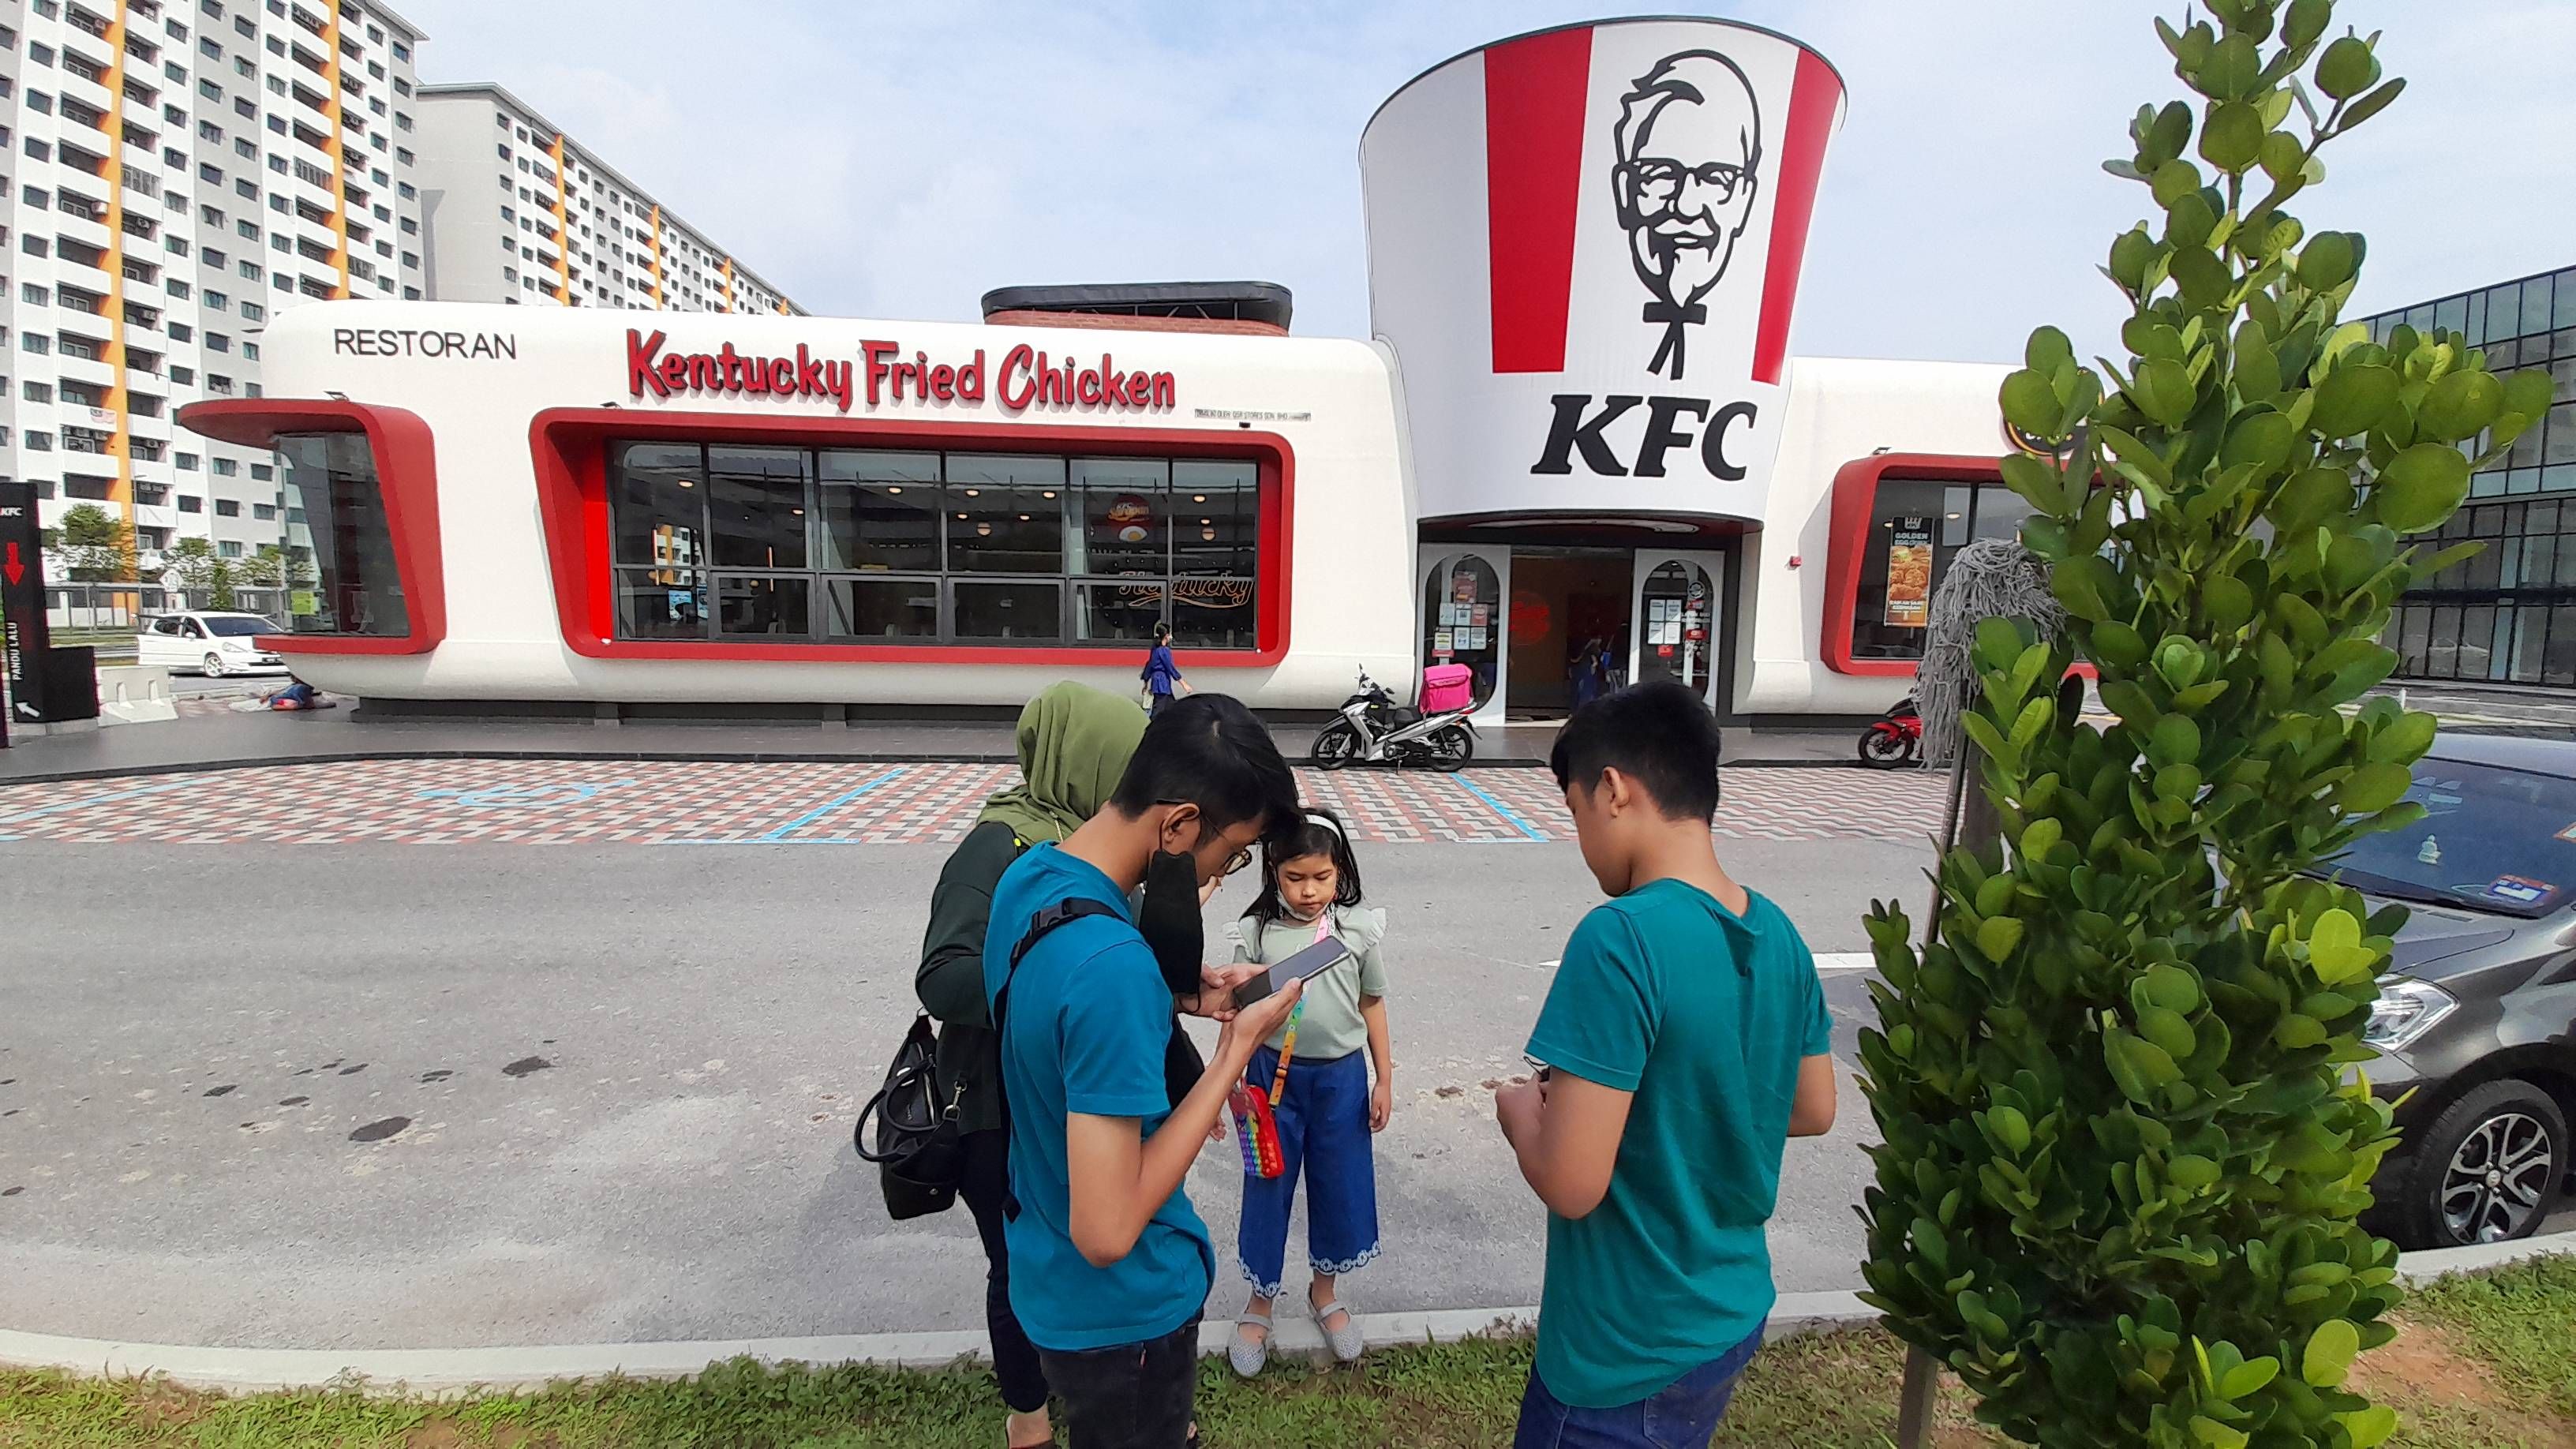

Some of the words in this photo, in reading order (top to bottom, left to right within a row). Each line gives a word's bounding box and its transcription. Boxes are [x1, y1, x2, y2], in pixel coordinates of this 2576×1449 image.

[334, 328, 516, 359] RESTORAN
[627, 328, 853, 412] Kentucky
[859, 339, 985, 404] Fried
[998, 343, 1176, 409] Chicken
[1530, 394, 1758, 481] KFC
[0, 507, 23, 516] KFC
[6, 622, 19, 647] LALU
[9, 649, 23, 680] PANDU
